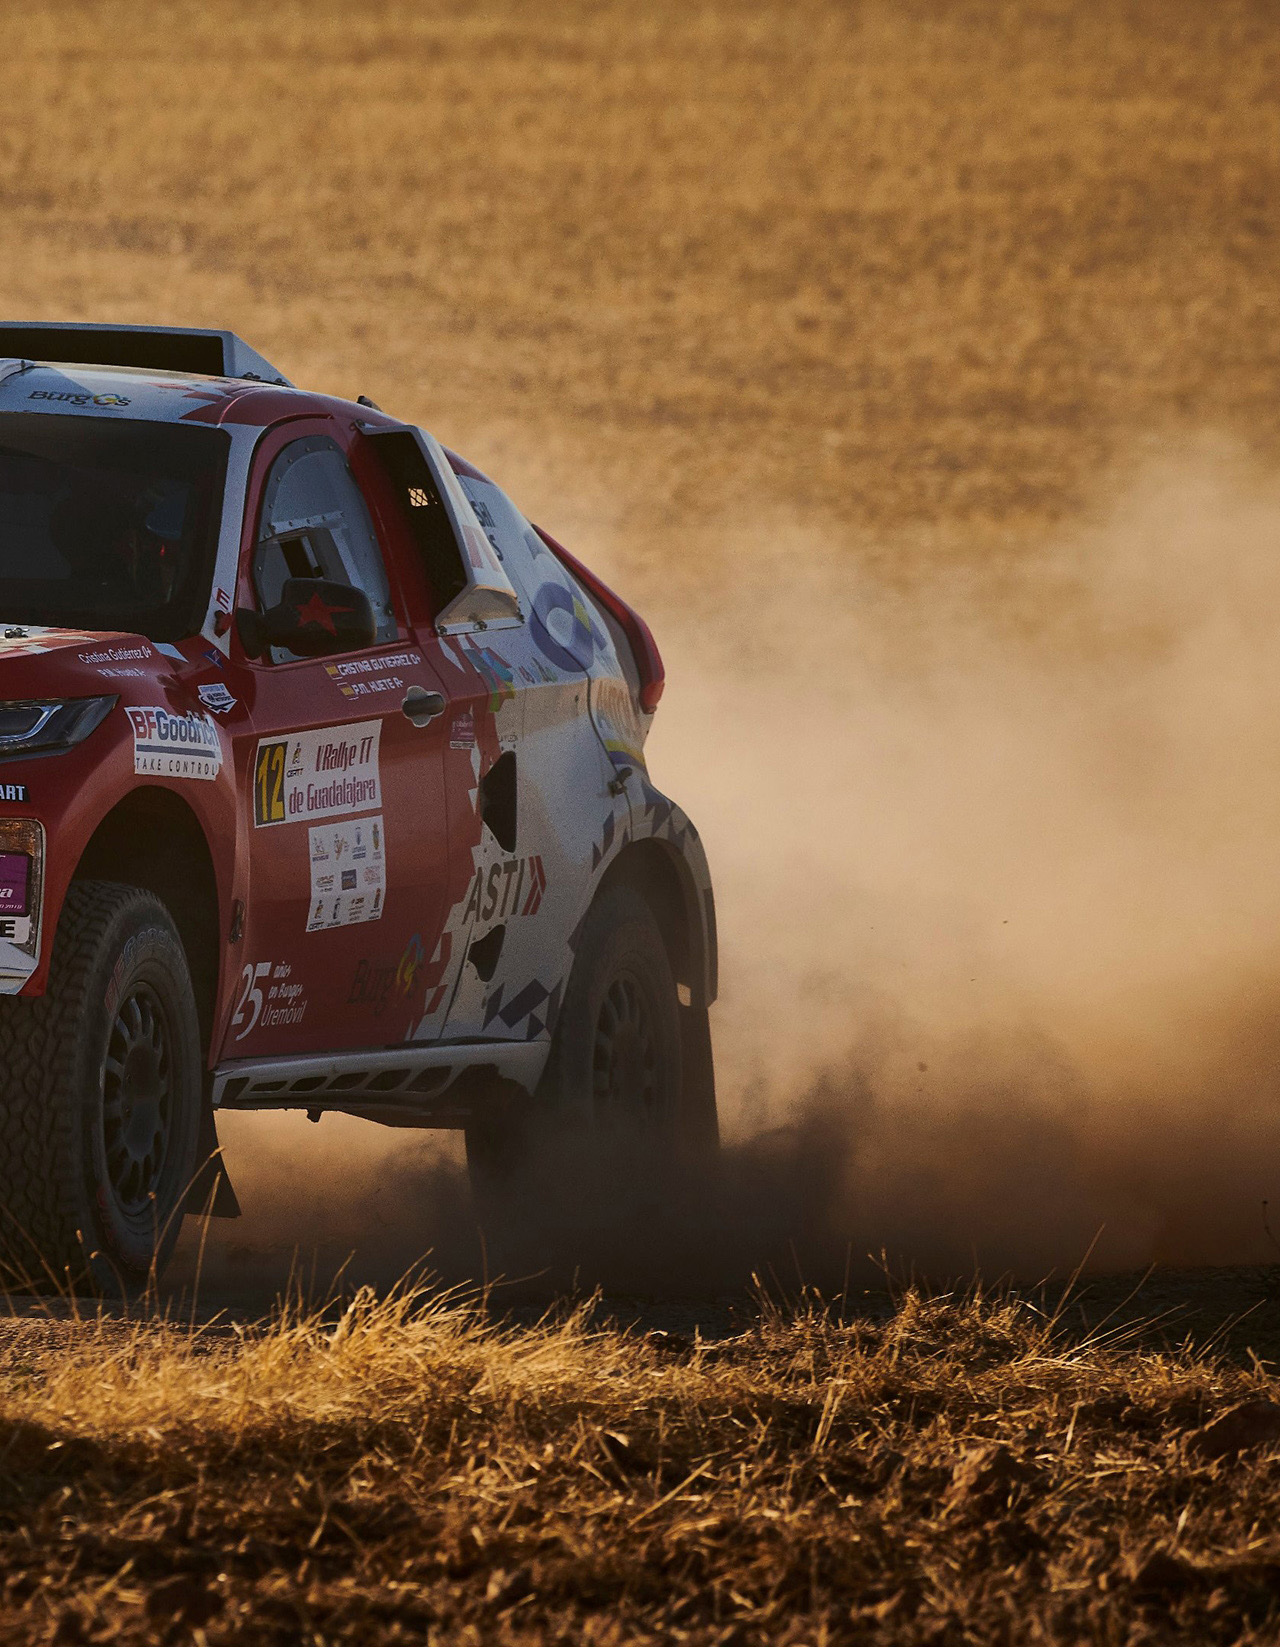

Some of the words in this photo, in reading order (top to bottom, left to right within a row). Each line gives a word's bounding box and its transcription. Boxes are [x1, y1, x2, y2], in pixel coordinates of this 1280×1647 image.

[78, 651, 110, 664] Cristina
[129, 711, 219, 746] BFGoodrich
[136, 758, 162, 771] TAKE
[169, 760, 215, 776] CONTROL
[322, 741, 357, 772] Rallye
[359, 736, 374, 764] TT
[258, 745, 284, 821] 12
[289, 787, 304, 813] de
[307, 776, 376, 810] Guadalajara
[461, 858, 525, 925] ASTI
[231, 961, 272, 1041] 25
